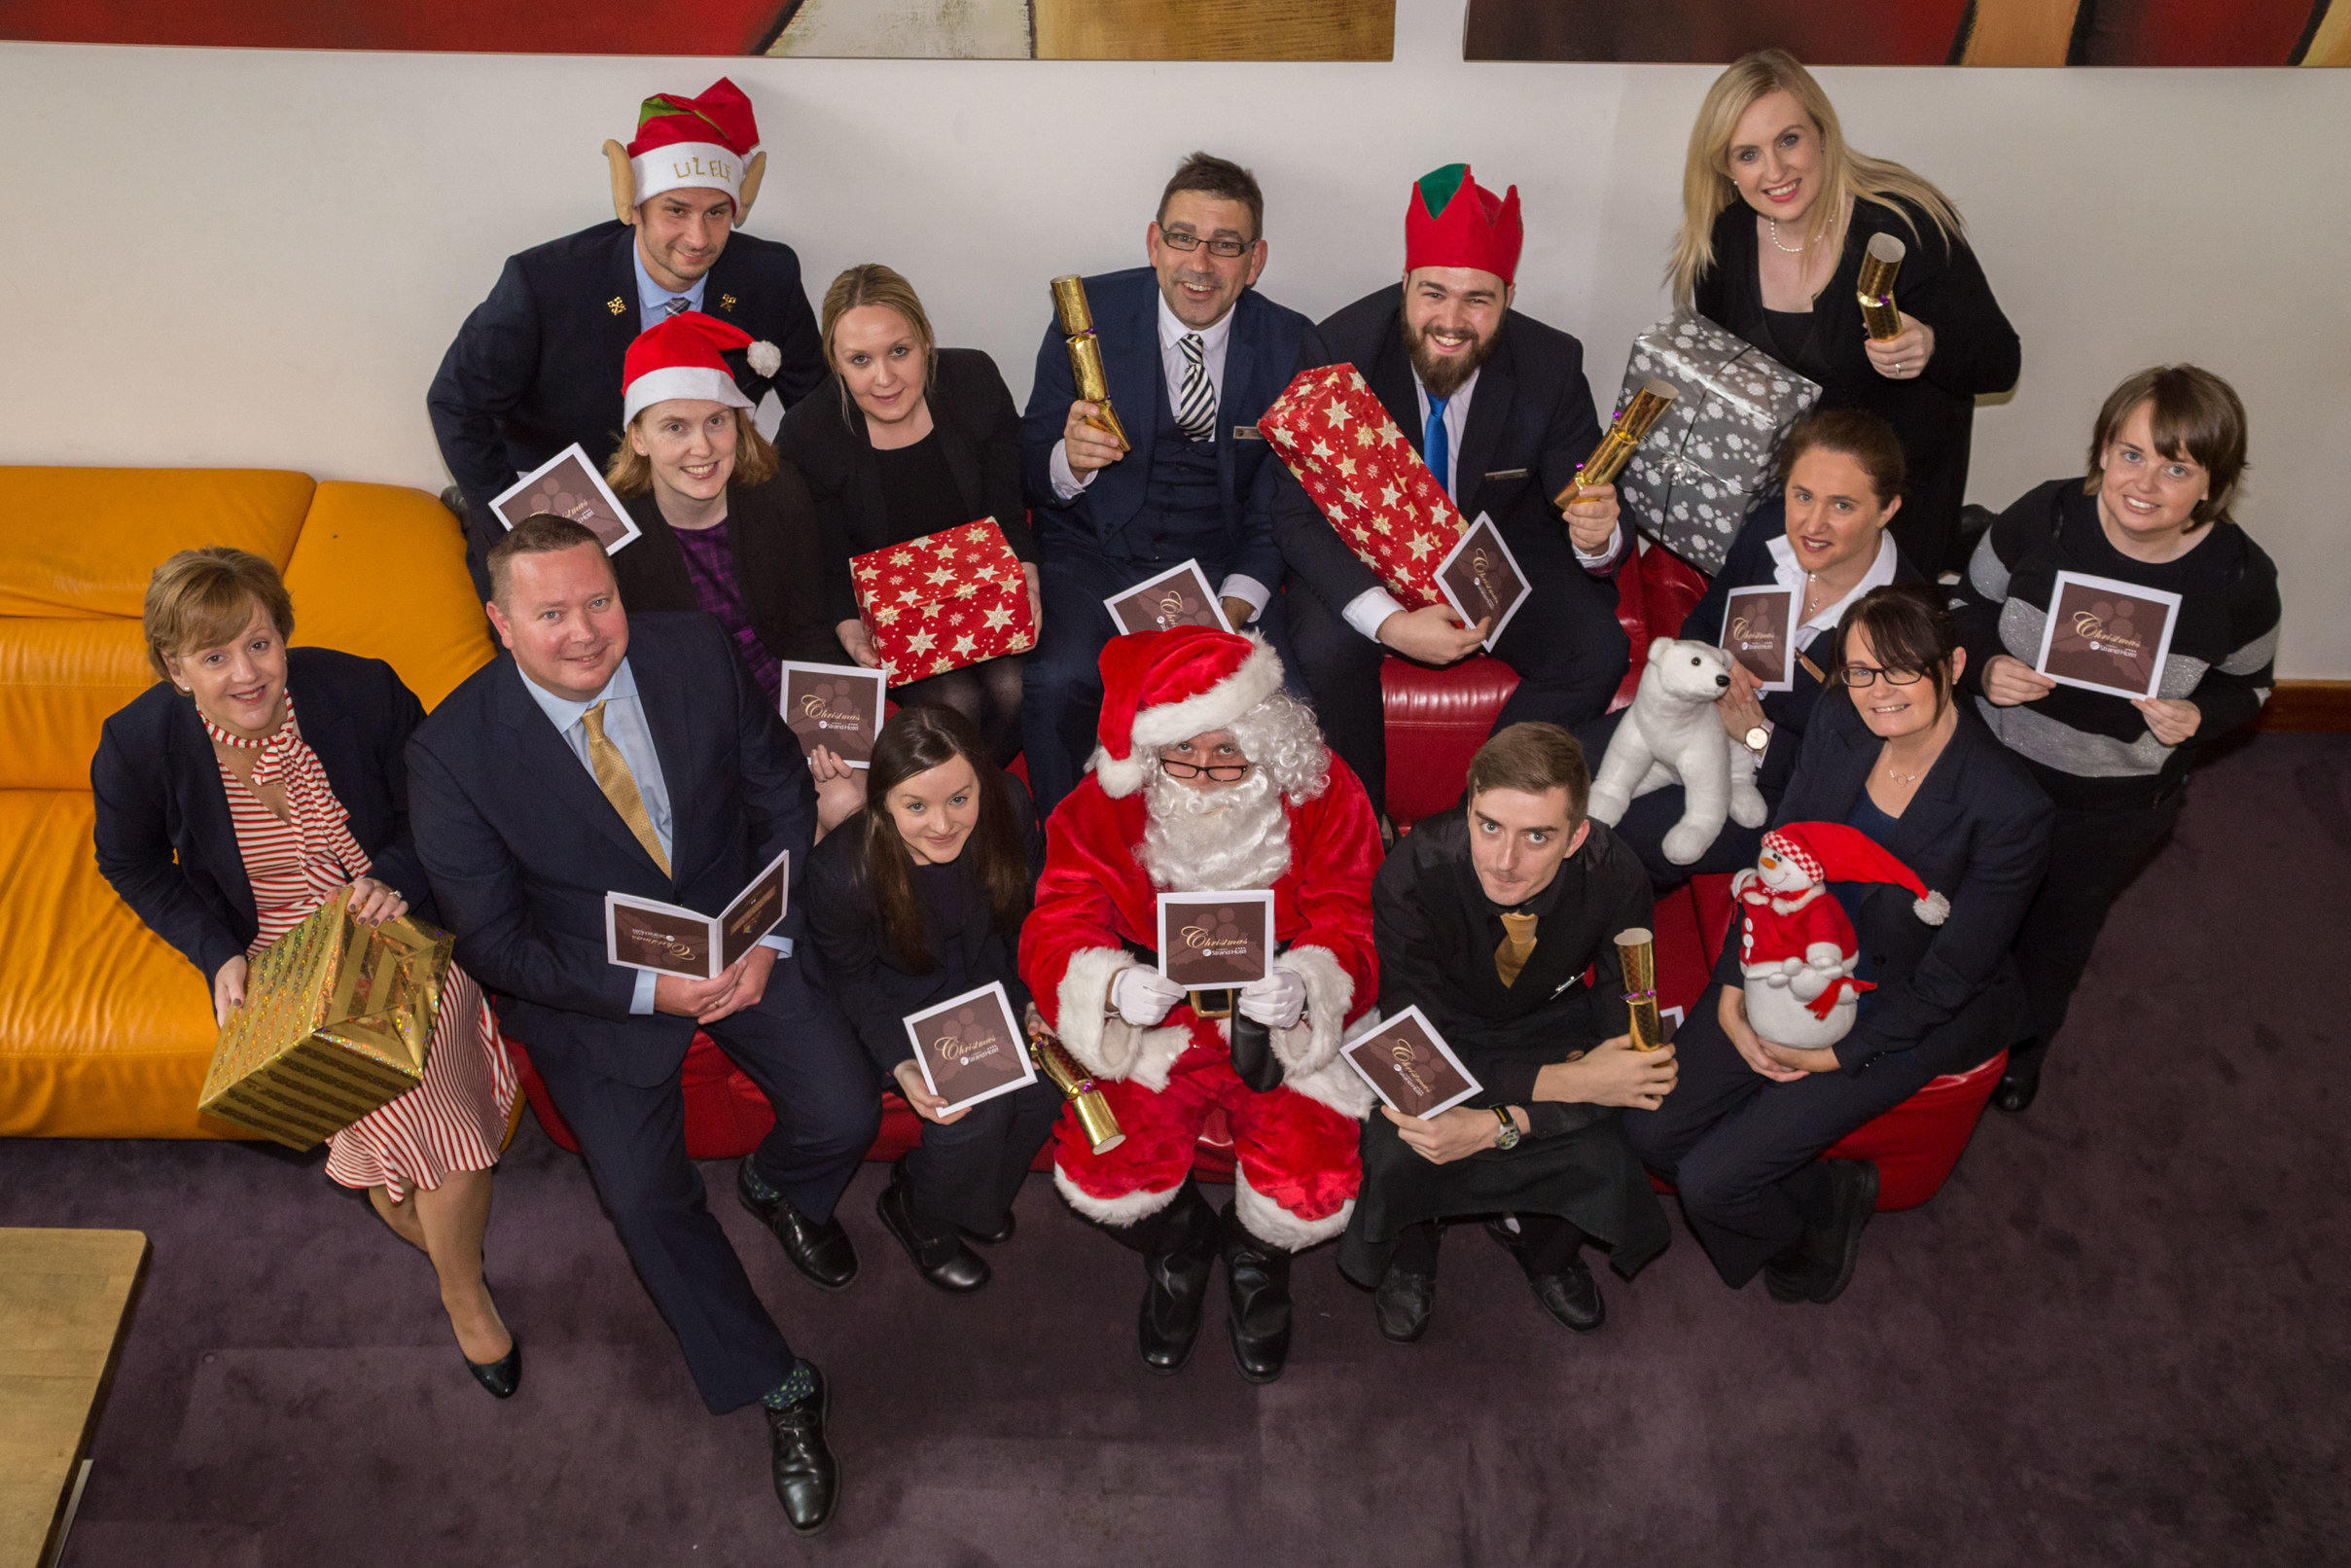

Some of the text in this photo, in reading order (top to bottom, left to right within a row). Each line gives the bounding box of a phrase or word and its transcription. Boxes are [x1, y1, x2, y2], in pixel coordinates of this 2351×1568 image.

[1733, 617, 1775, 641] Christmas
[2073, 611, 2141, 648] Christmas
[801, 695, 860, 721] Christmas
[631, 935, 696, 961] Christmas
[1181, 926, 1248, 948] Christmas
[934, 1035, 997, 1060] Christmas
[1392, 1038, 1433, 1092] Christmas
